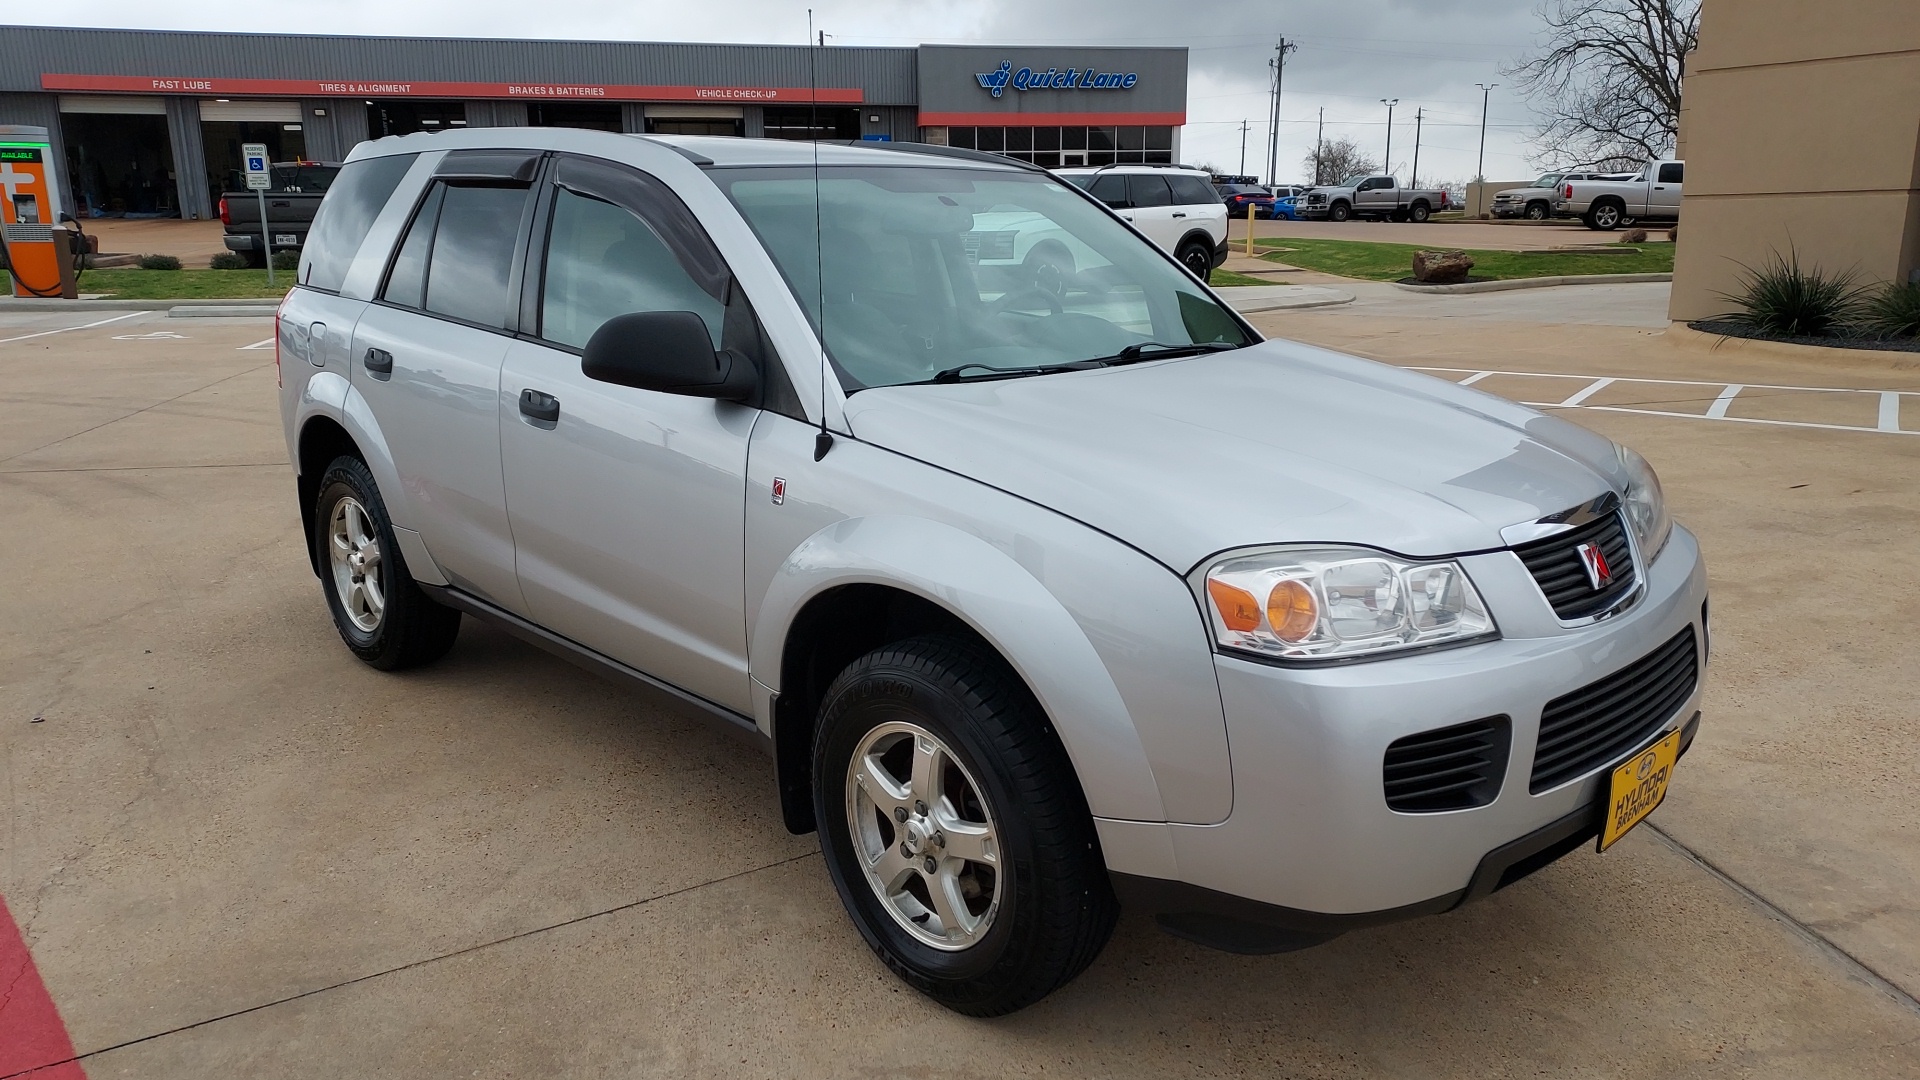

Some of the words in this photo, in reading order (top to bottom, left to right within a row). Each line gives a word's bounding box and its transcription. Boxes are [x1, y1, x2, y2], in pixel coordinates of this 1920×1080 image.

[1013, 67, 1081, 90] Quick
[1079, 68, 1137, 88] Lane
[152, 80, 180, 89] FAST
[183, 81, 212, 90] LUBE
[319, 83, 347, 92] TIRES
[348, 84, 356, 93] &
[357, 84, 411, 93] ALIGNMENT
[508, 86, 546, 95] BRAKES
[548, 87, 555, 95] &
[556, 87, 605, 96] BATTERIES
[695, 89, 732, 98] VEHICLE
[733, 90, 777, 98] CHECK-UP
[1615, 764, 1669, 819] HYUNDAI
[1615, 787, 1660, 834] BRENHAM
